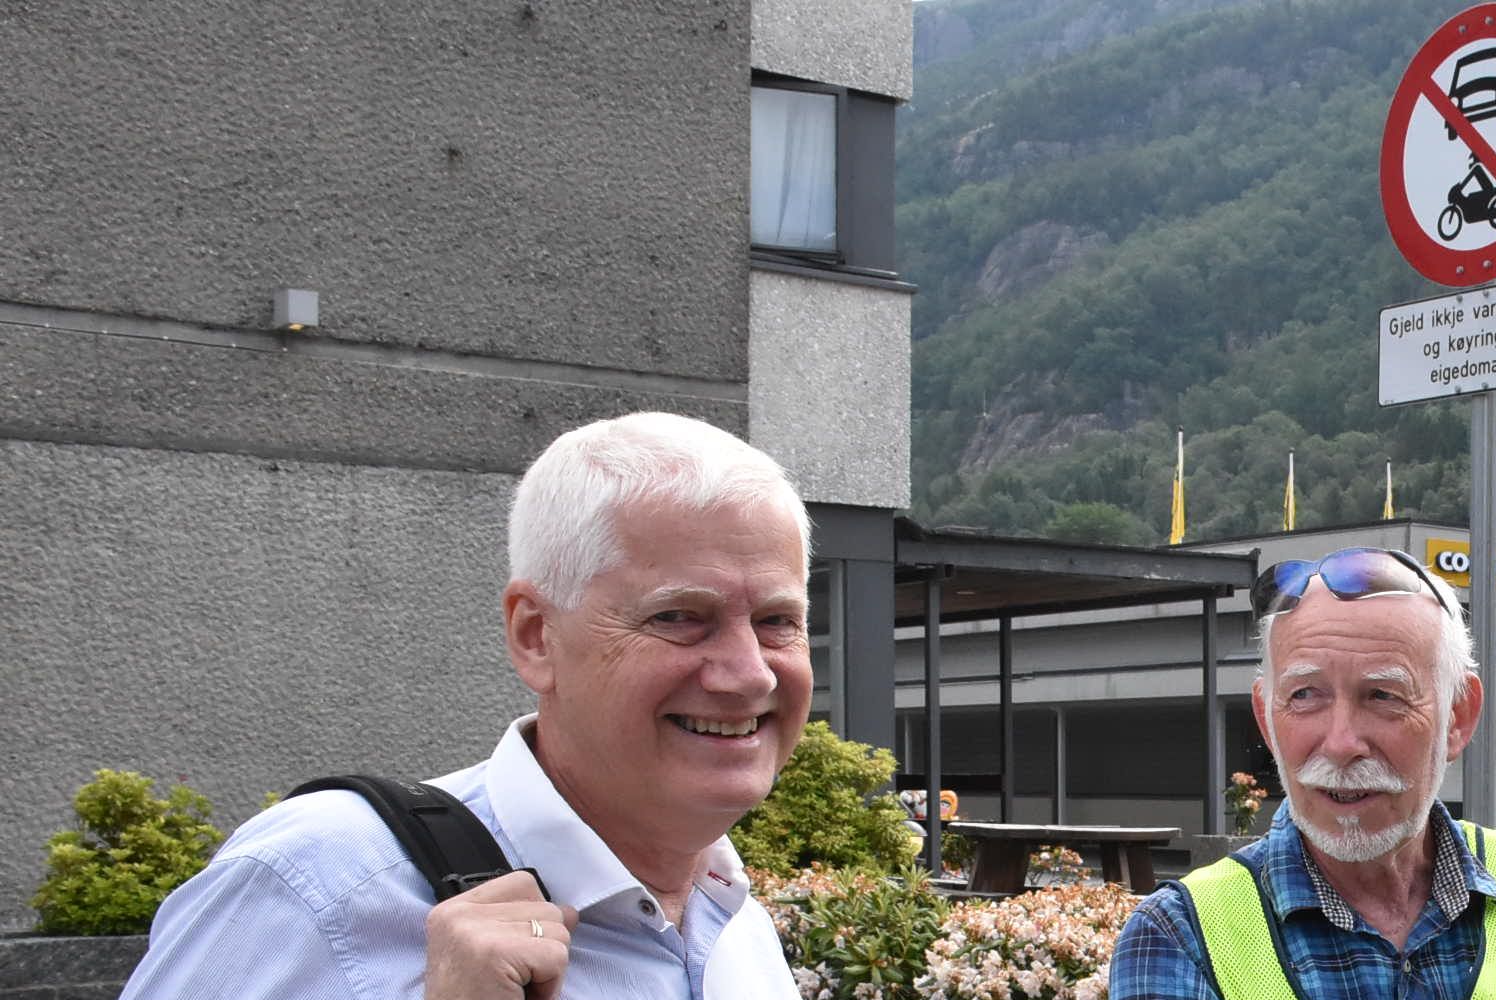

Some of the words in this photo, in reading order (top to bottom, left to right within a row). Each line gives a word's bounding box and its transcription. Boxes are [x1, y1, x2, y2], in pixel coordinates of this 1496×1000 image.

[1389, 313, 1424, 338] Gjeld
[1431, 308, 1464, 329] ikkje
[1423, 340, 1440, 359] og
